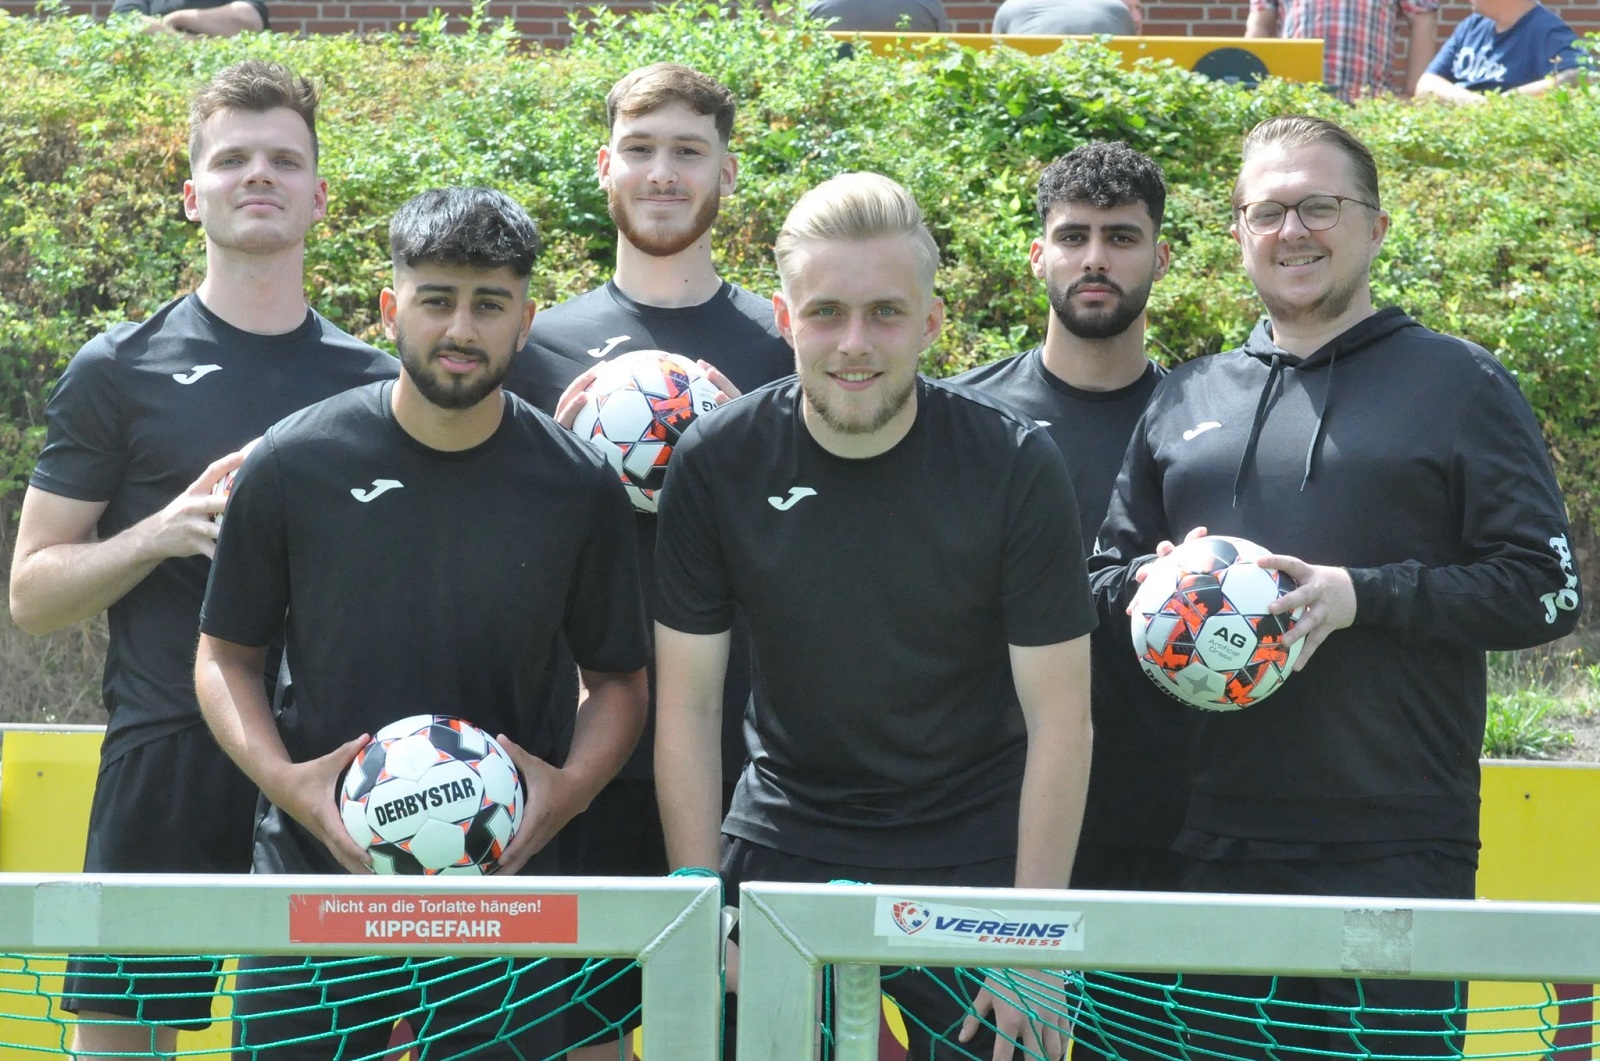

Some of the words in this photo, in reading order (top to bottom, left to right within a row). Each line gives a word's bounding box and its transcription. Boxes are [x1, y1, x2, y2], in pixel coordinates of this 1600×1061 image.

[1212, 626, 1247, 649] AG
[1208, 639, 1241, 657] Artificial
[1208, 646, 1233, 662] Grass
[374, 777, 477, 827] DERBYSTAR
[324, 899, 364, 913] Nicht
[369, 902, 387, 913] an
[393, 900, 415, 913] die
[418, 900, 476, 913] Torlatte
[480, 900, 541, 915] hängen!
[365, 920, 501, 938] KIPPGEFAHR
[935, 916, 1069, 938] VEREINS
[978, 935, 1062, 947] EXPRESS
